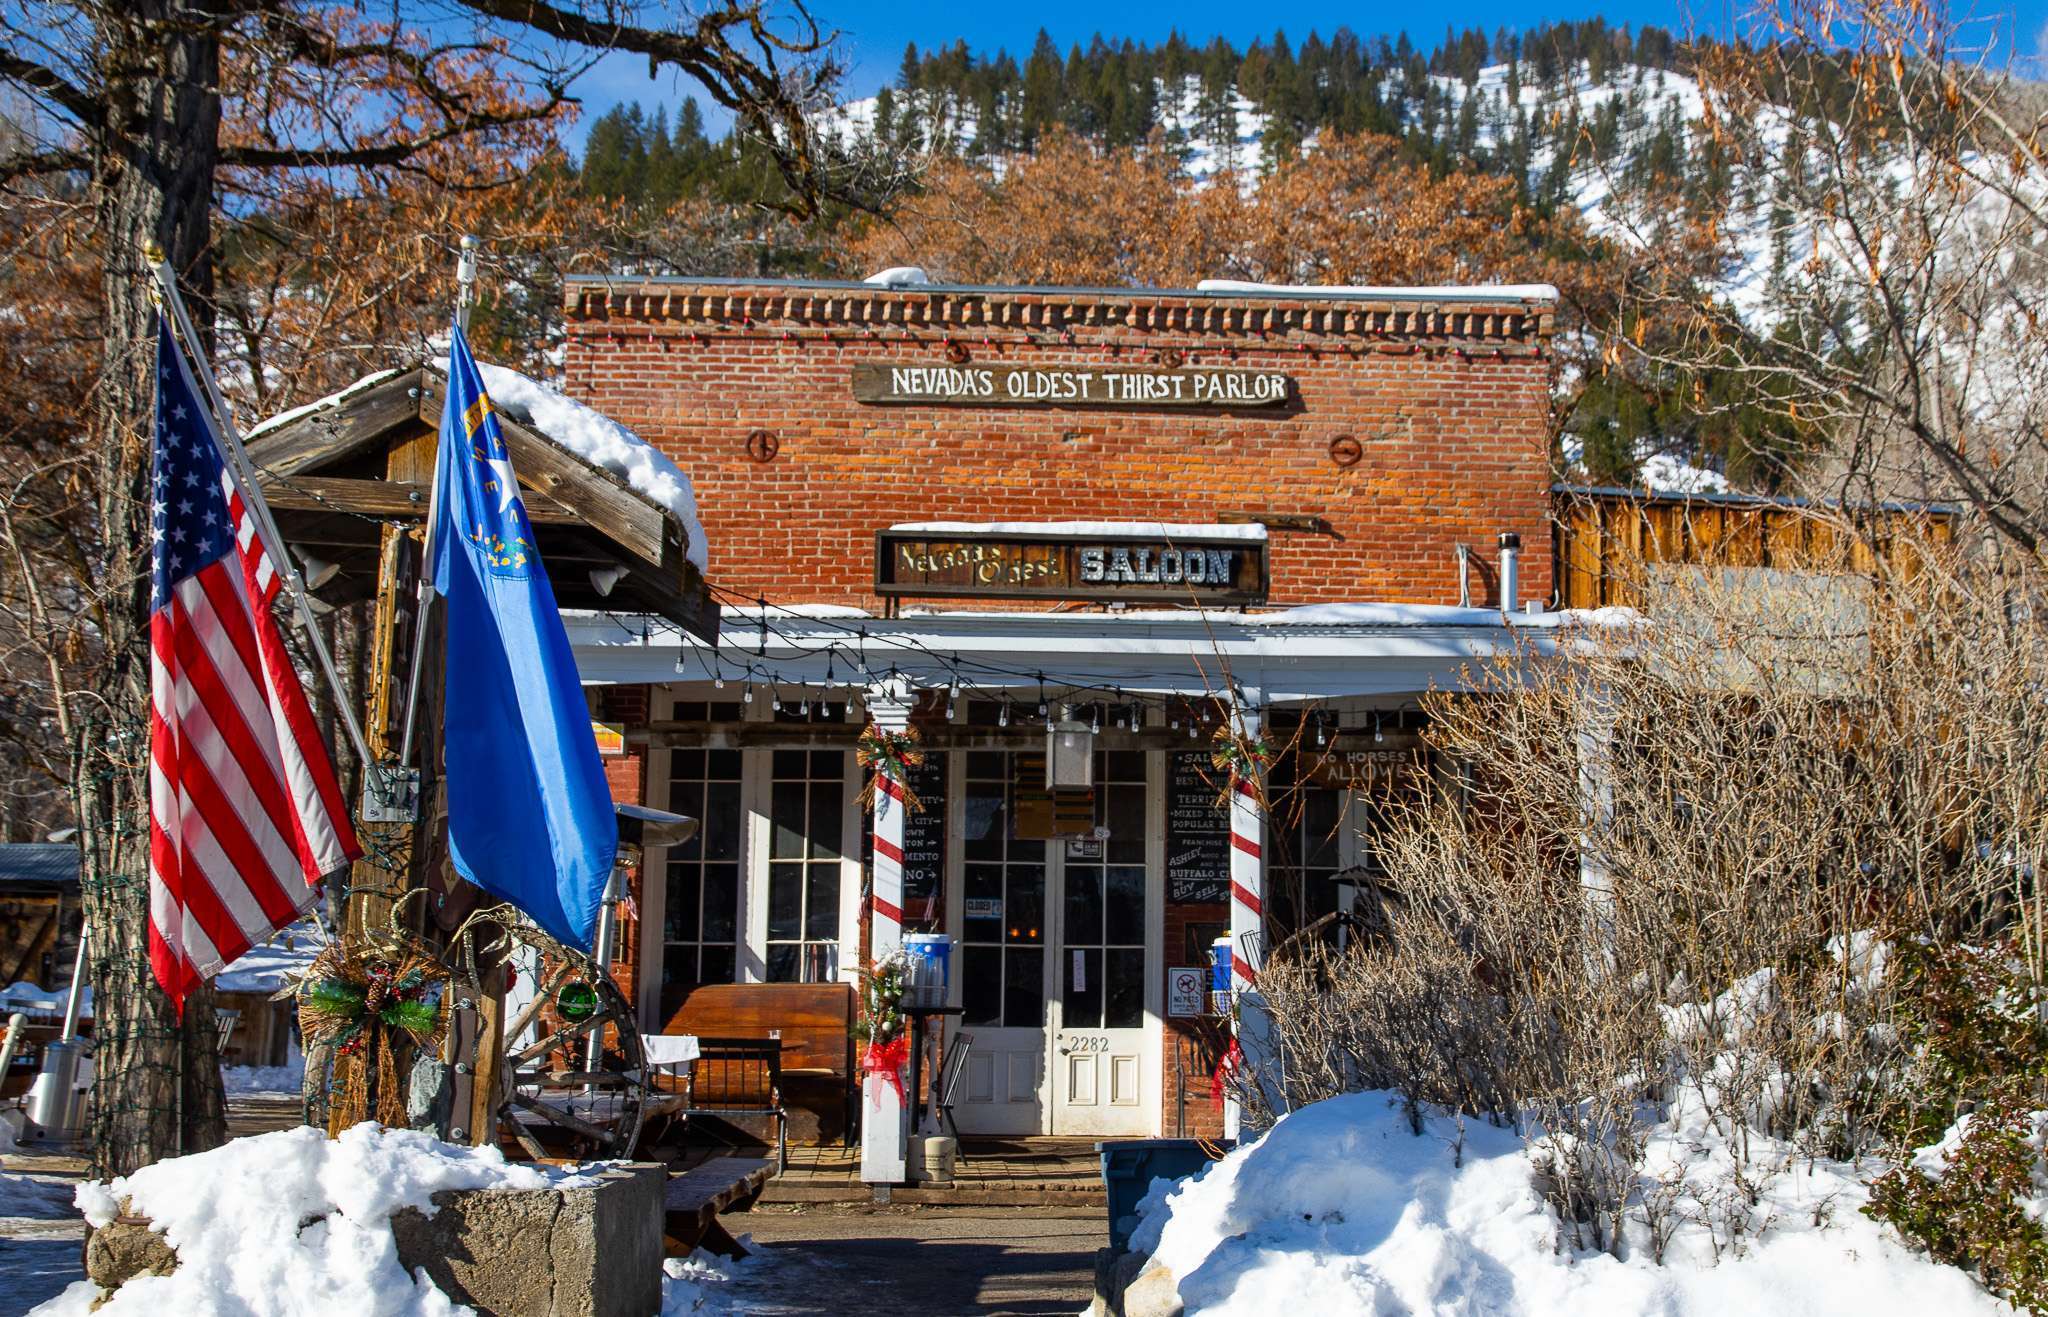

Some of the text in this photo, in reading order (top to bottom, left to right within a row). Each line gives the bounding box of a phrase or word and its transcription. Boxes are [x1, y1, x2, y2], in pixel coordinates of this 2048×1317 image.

[891, 368, 1287, 400] NEVADA'S OLDEST THIRST PARLOR
[1079, 546, 1233, 584] SALOON
[1184, 753, 1210, 764] SAL
[1347, 751, 1407, 763] HORSES
[1174, 809, 1204, 818] MIXED
[1170, 869, 1215, 878] BUFFALO
[1173, 882, 1195, 898] BUY
[1195, 884, 1219, 899] SELL
[1070, 1036, 1109, 1052] 2282
